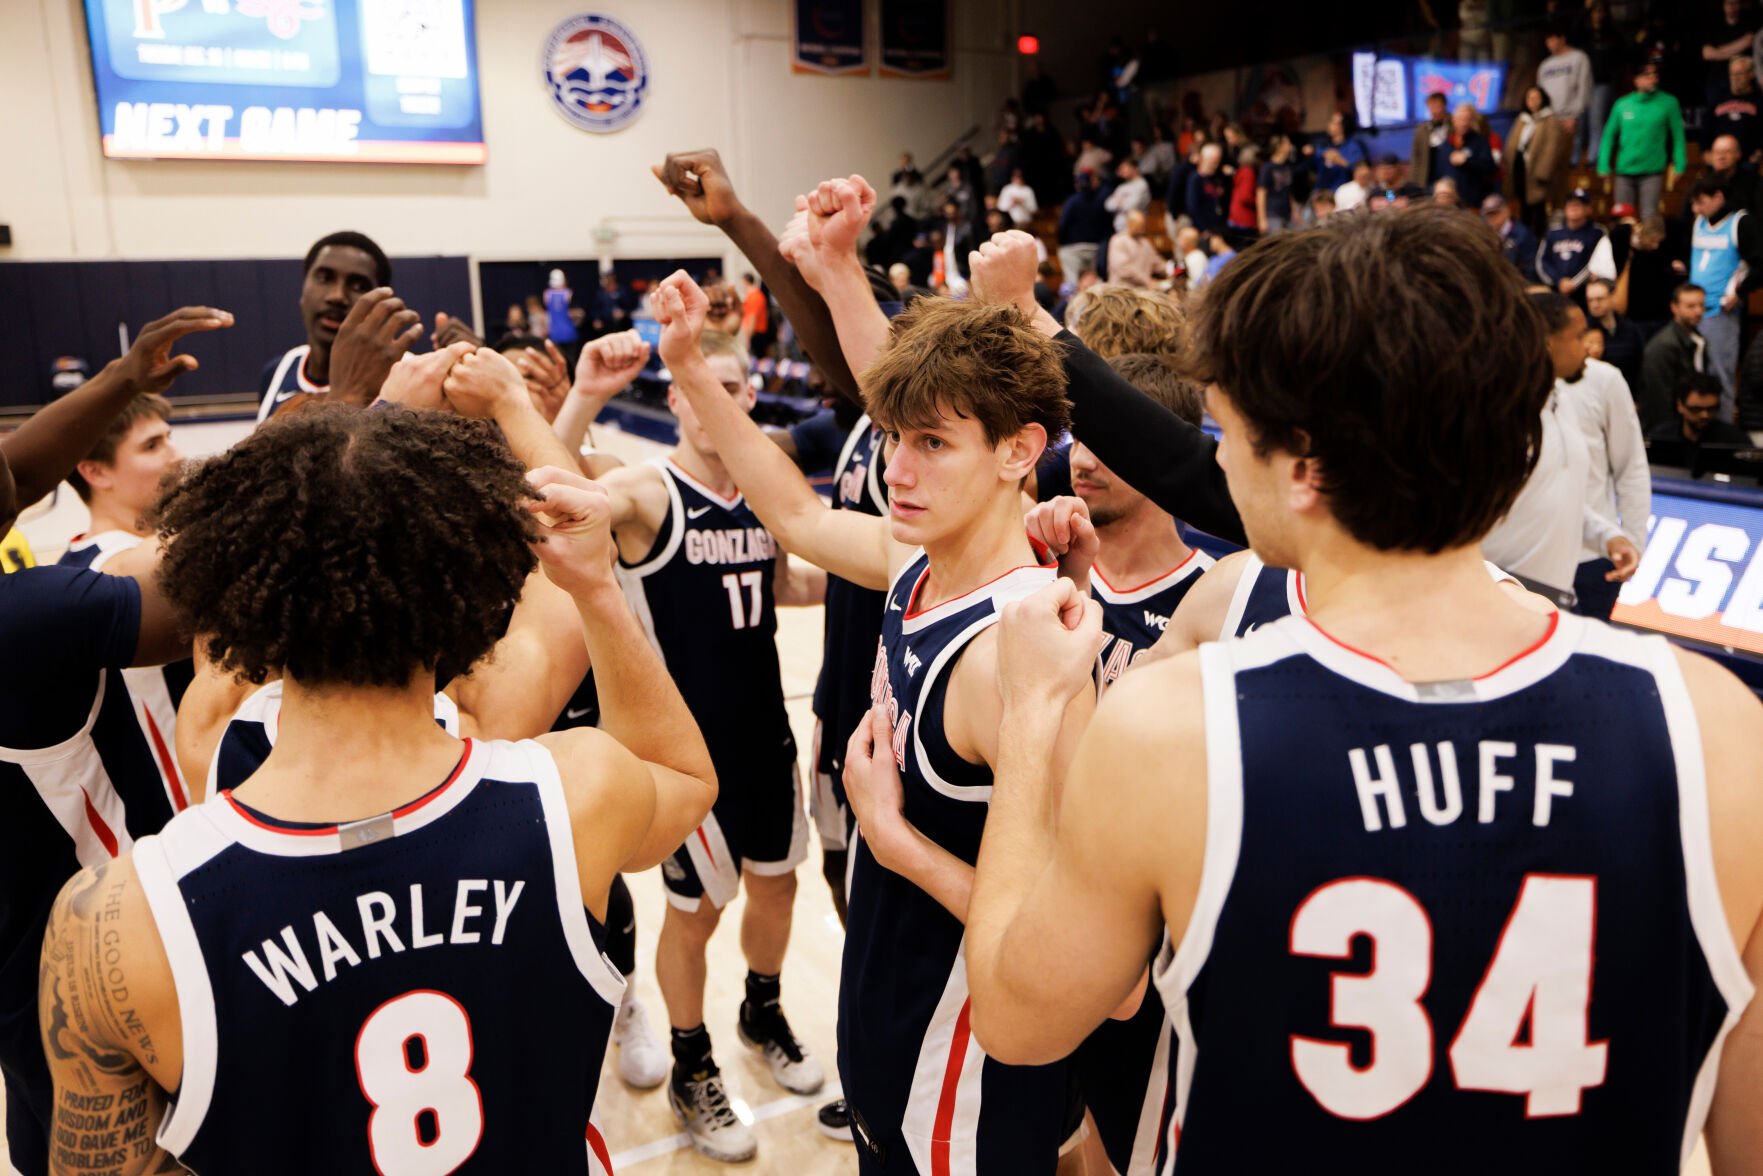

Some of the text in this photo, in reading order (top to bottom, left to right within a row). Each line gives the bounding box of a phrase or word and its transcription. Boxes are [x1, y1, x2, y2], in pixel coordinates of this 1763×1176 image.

[114, 101, 361, 154] NEXT GAME
[722, 570, 763, 630] 17
[1348, 741, 1577, 831] HUFF
[104, 880, 126, 923] THE
[103, 930, 129, 1003] GOOD
[242, 879, 525, 1007] WARLEY
[1288, 872, 1610, 1121] 34
[65, 1090, 115, 1111] PRAYED
[354, 988, 484, 1176] 8
[80, 1130, 122, 1151] GAVE
[122, 1116, 149, 1145] ME
[114, 1099, 148, 1128] AND
[56, 1138, 151, 1169] PROBLEMS TO
